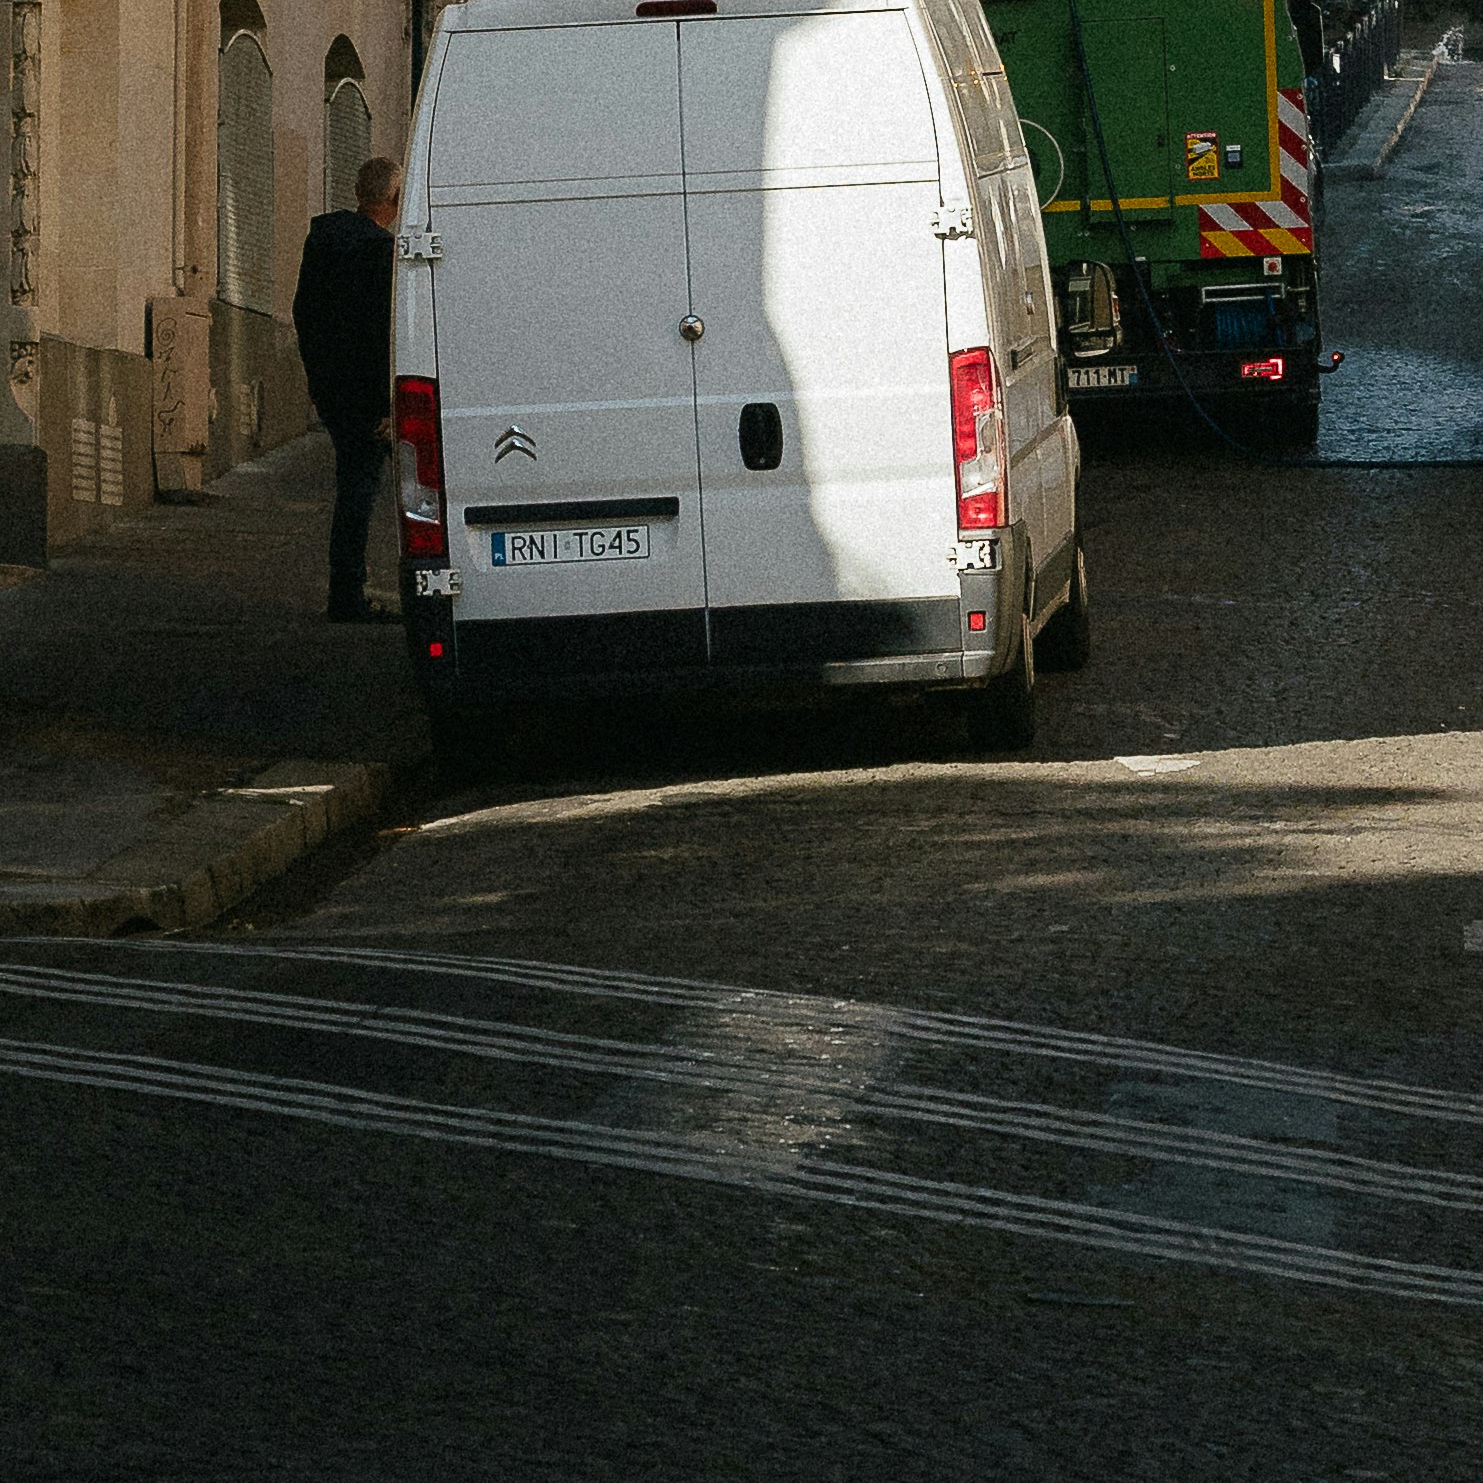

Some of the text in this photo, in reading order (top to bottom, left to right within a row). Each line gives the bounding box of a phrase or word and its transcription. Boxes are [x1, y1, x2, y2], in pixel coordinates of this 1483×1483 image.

[511, 529, 641, 561] RNI TG45
[494, 552, 504, 560] PL
